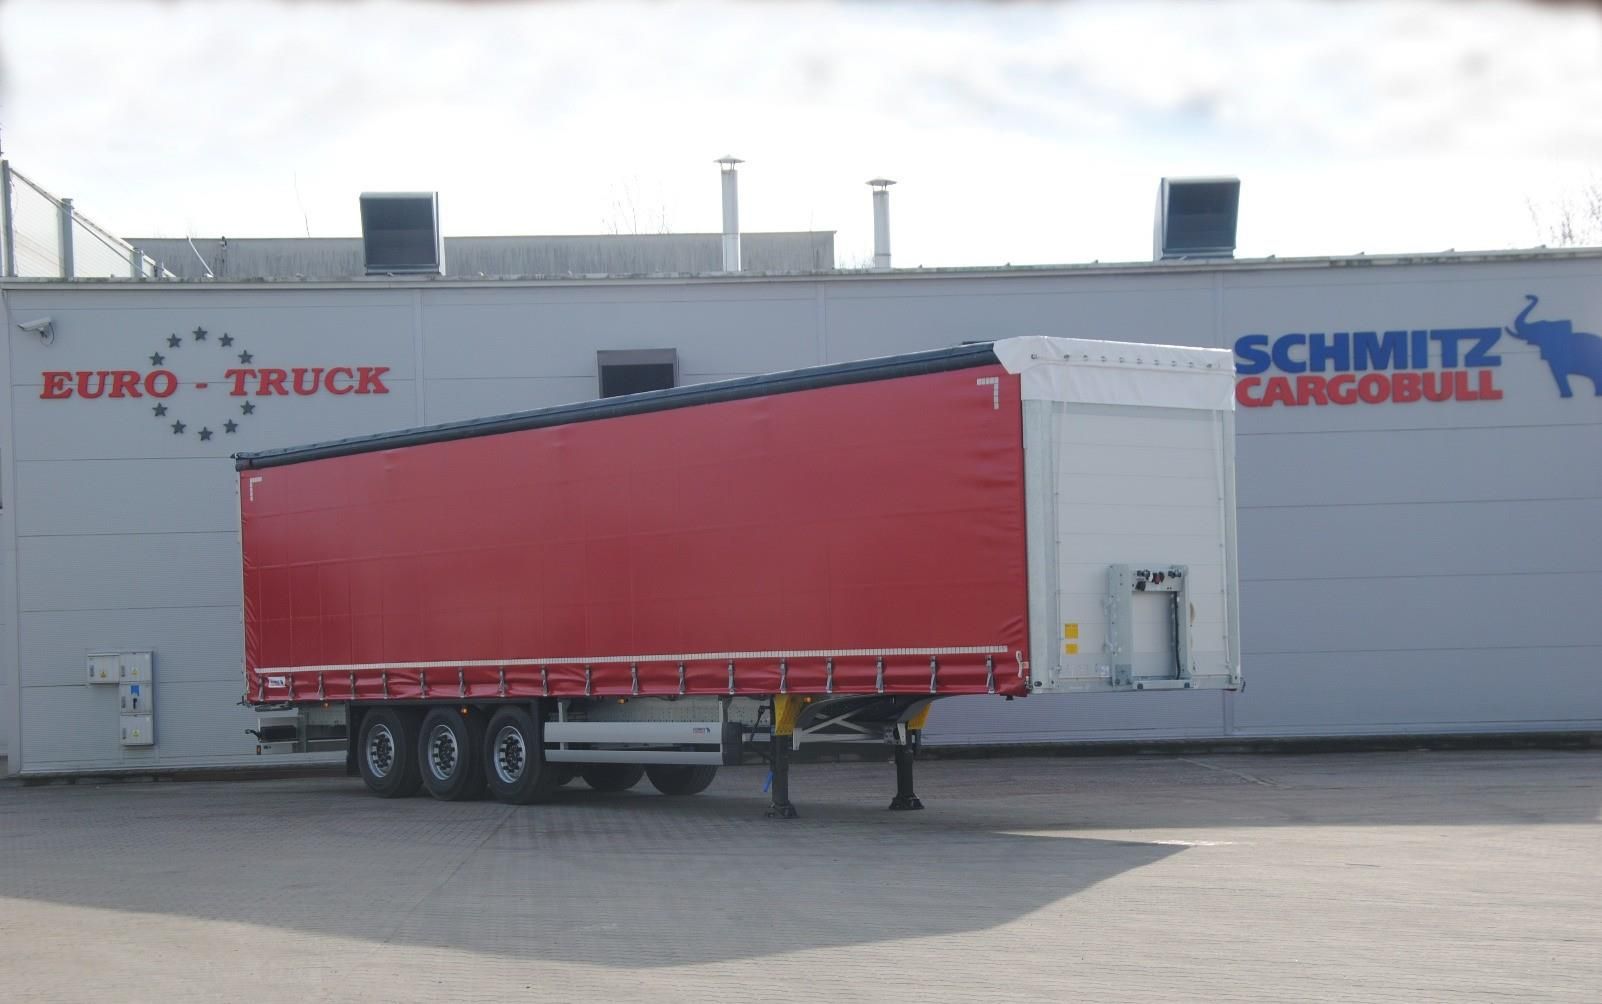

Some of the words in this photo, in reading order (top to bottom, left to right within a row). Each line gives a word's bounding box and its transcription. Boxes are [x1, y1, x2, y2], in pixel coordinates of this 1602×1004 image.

[1234, 327, 1503, 374] SCHMITZ
[40, 370, 178, 399] EURO
[224, 367, 390, 396] TRUCK
[1235, 370, 1503, 407] CARGOBULL
